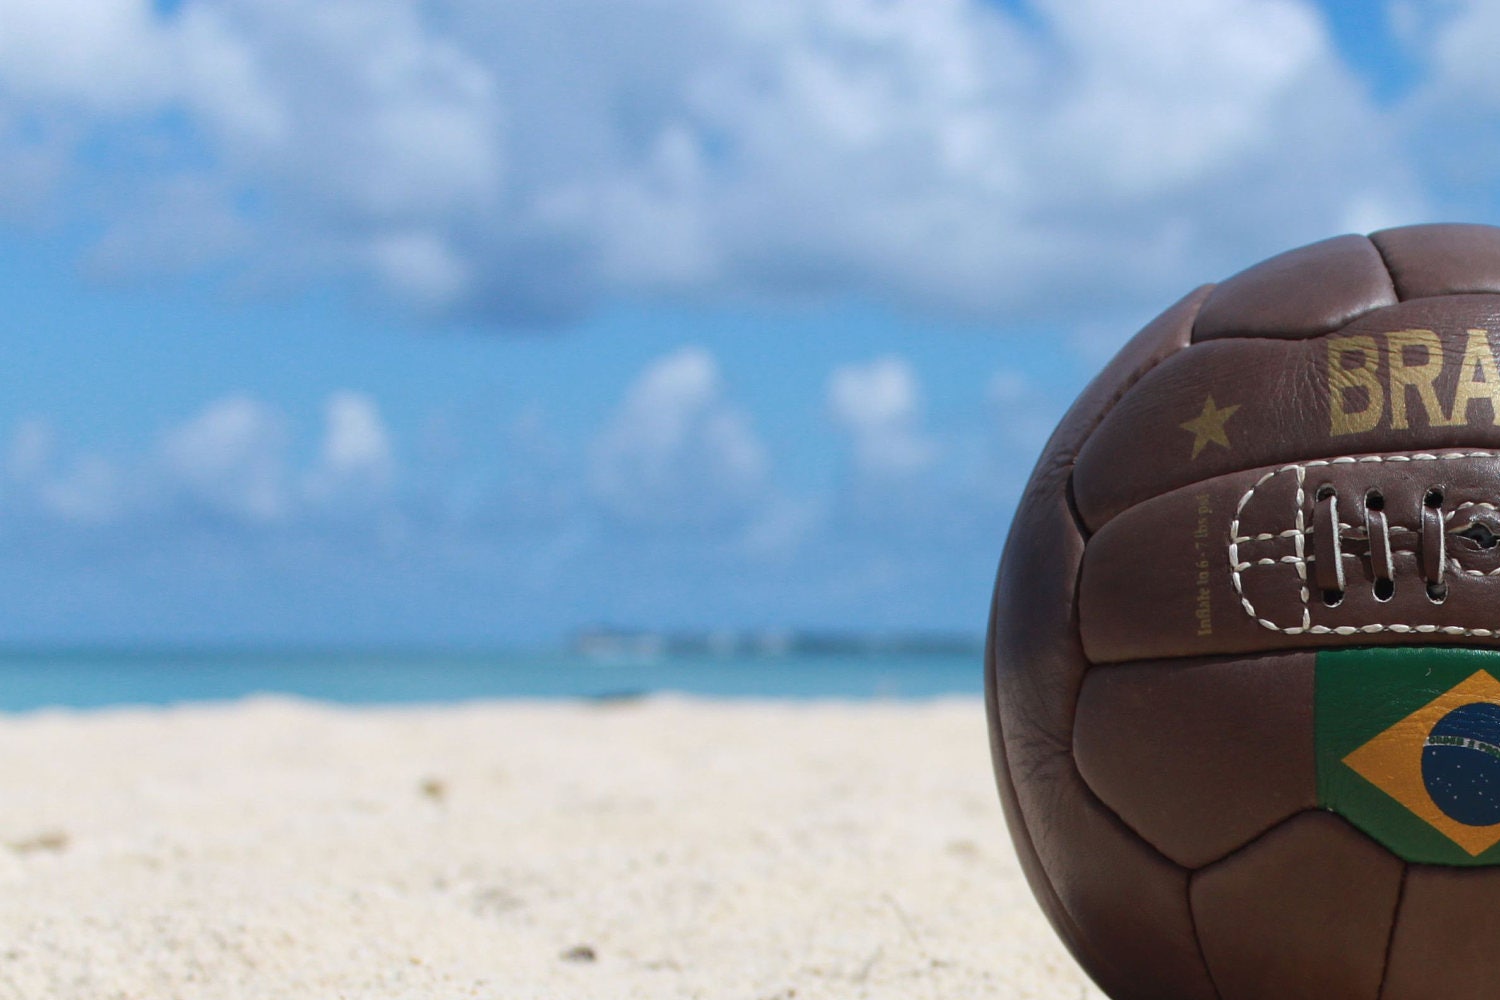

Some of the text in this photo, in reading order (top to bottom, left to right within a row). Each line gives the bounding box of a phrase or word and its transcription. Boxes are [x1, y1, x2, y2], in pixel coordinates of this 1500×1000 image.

[1195, 493, 1213, 514] psi
[1193, 518, 1209, 538] lbs
[1194, 541, 1208, 550] 7
[1196, 561, 1209, 569] 6
[1196, 571, 1209, 585] to
[1195, 588, 1213, 636] Inflate
